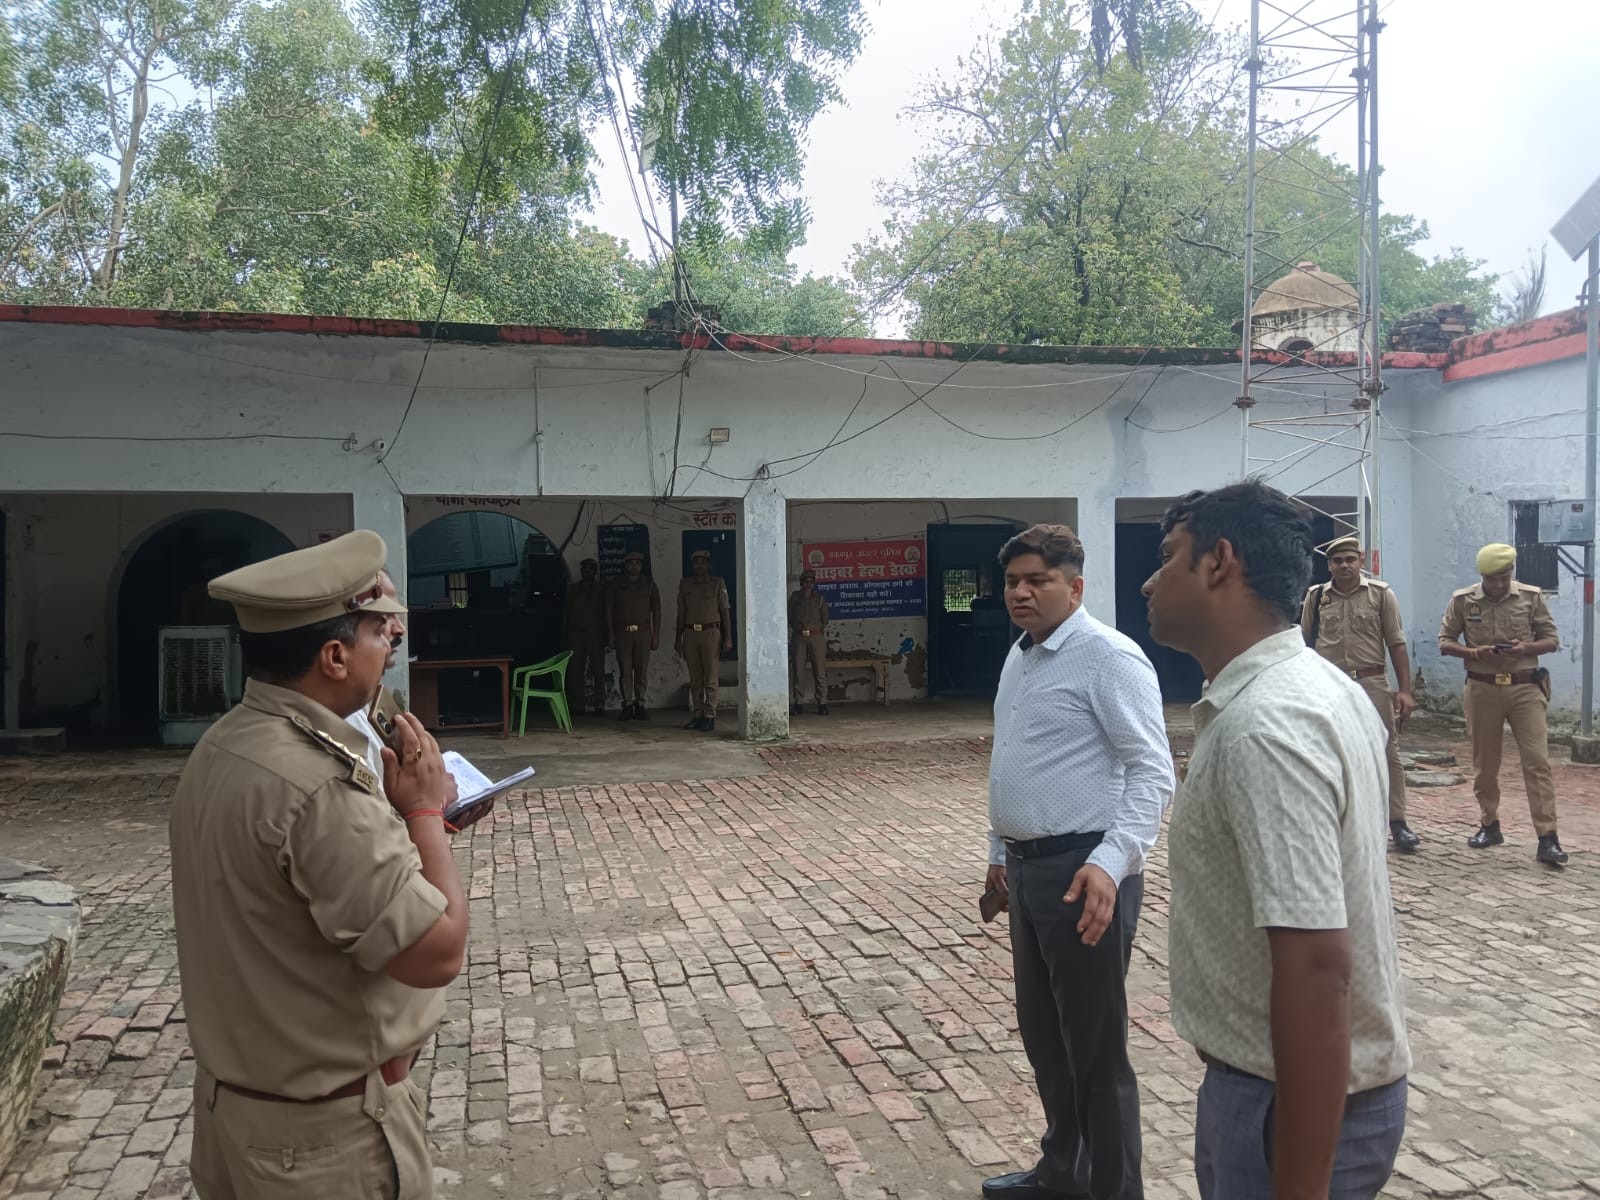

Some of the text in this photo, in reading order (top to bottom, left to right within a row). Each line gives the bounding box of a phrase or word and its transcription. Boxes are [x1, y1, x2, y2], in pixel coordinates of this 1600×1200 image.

[812, 560, 919, 580] साइबर हेल्प डेस्क
